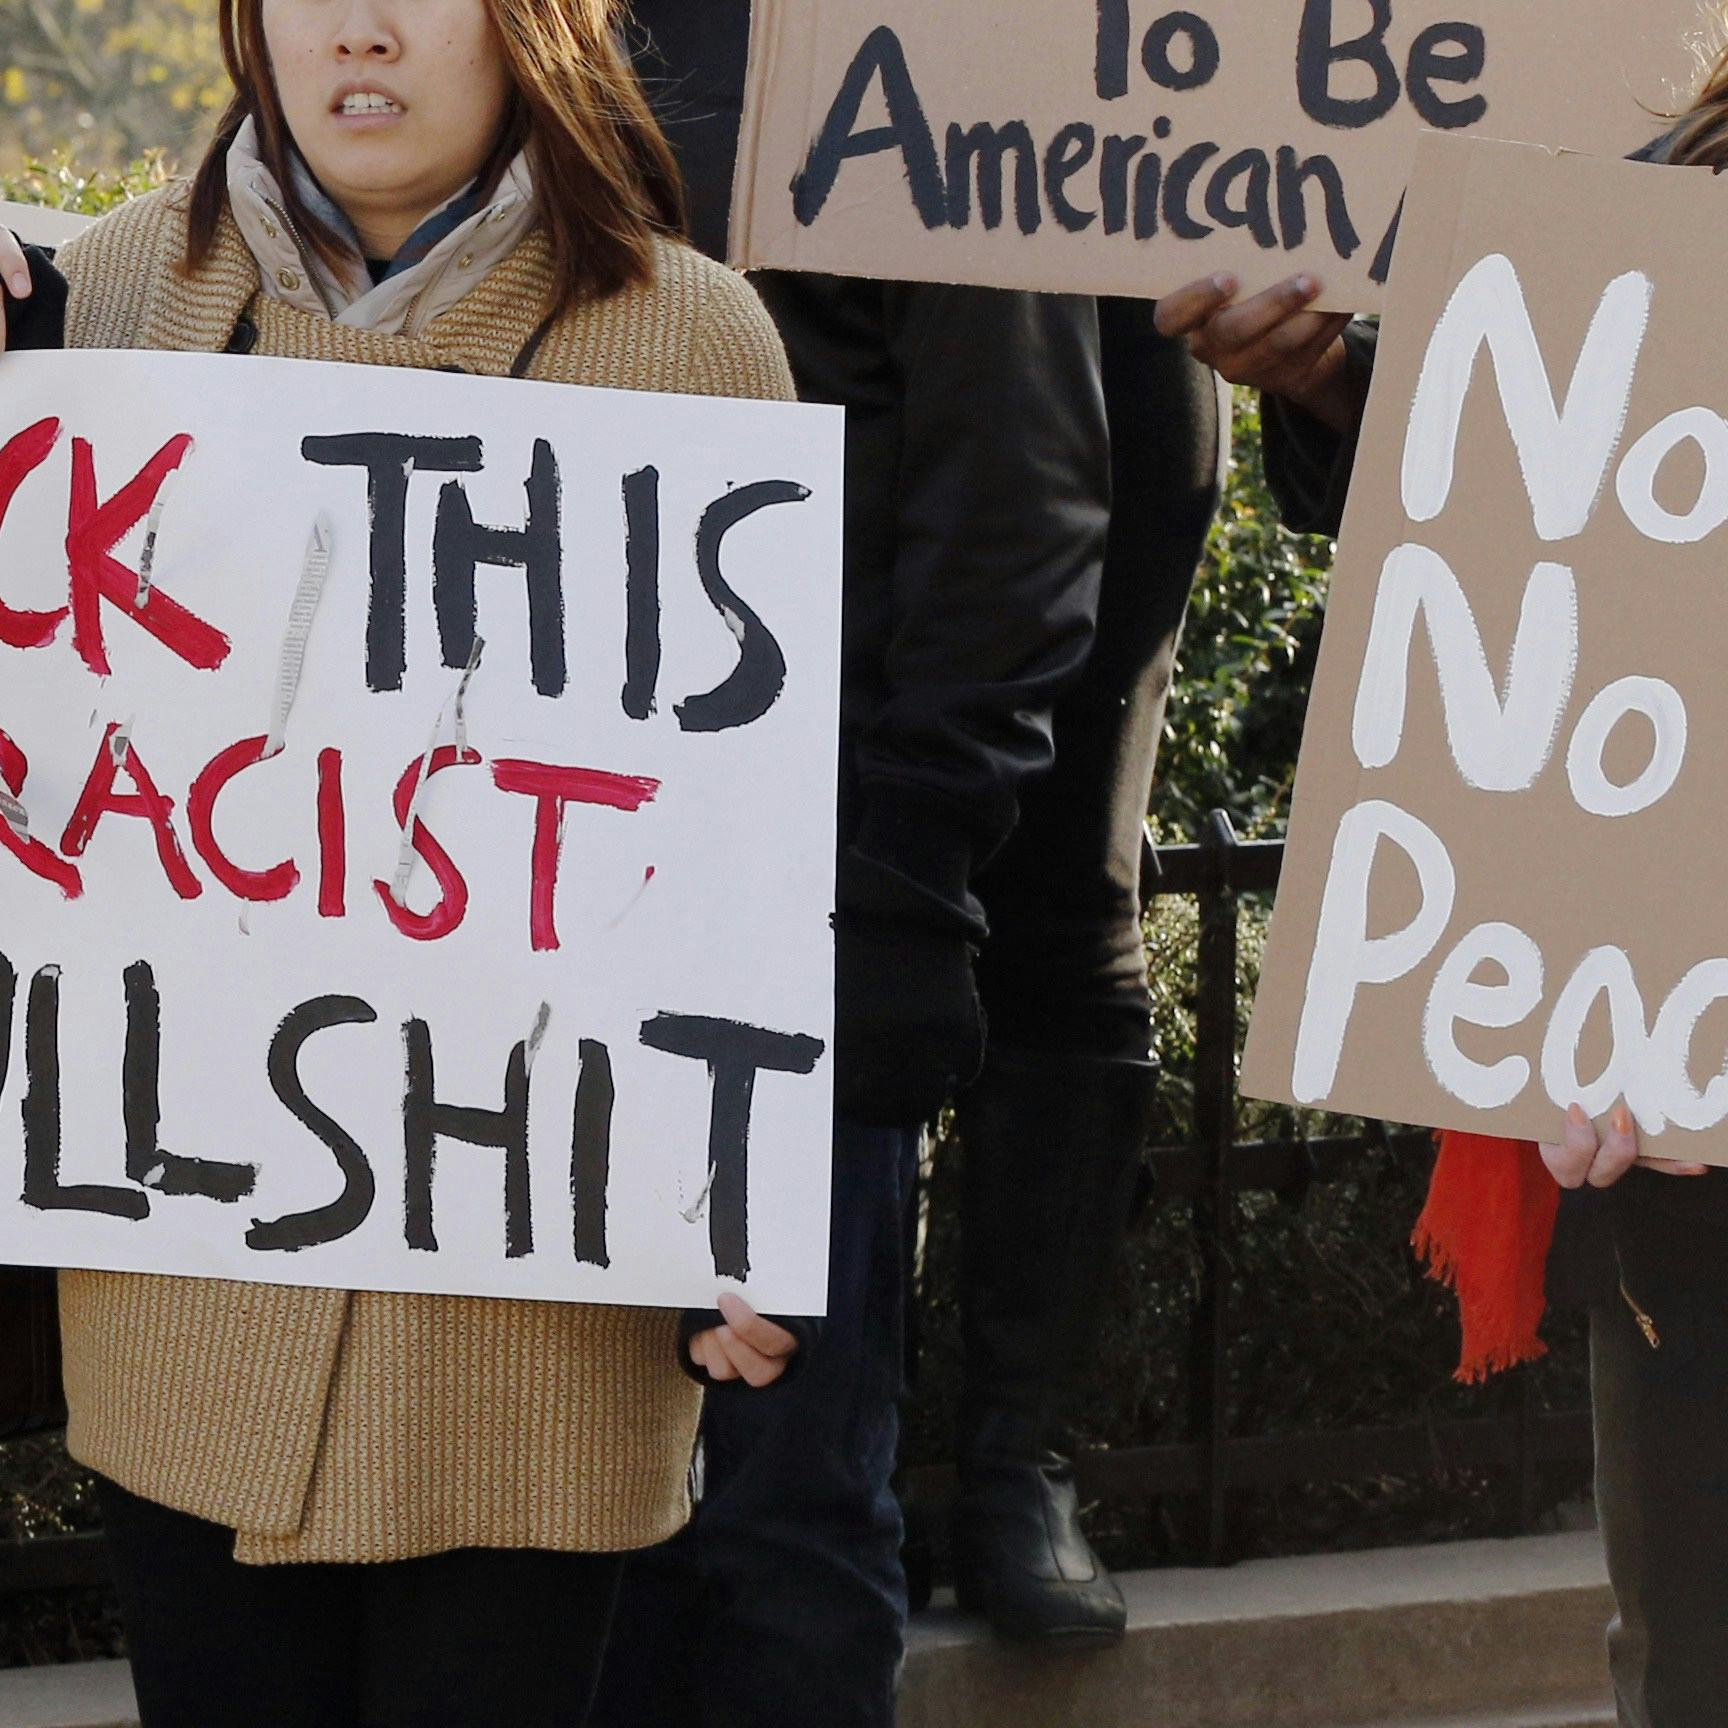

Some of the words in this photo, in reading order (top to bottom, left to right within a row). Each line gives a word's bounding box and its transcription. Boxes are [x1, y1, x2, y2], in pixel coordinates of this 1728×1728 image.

[1401, 252, 1728, 545] No
[301, 430, 813, 733] THIS
[1351, 541, 1687, 817] No
